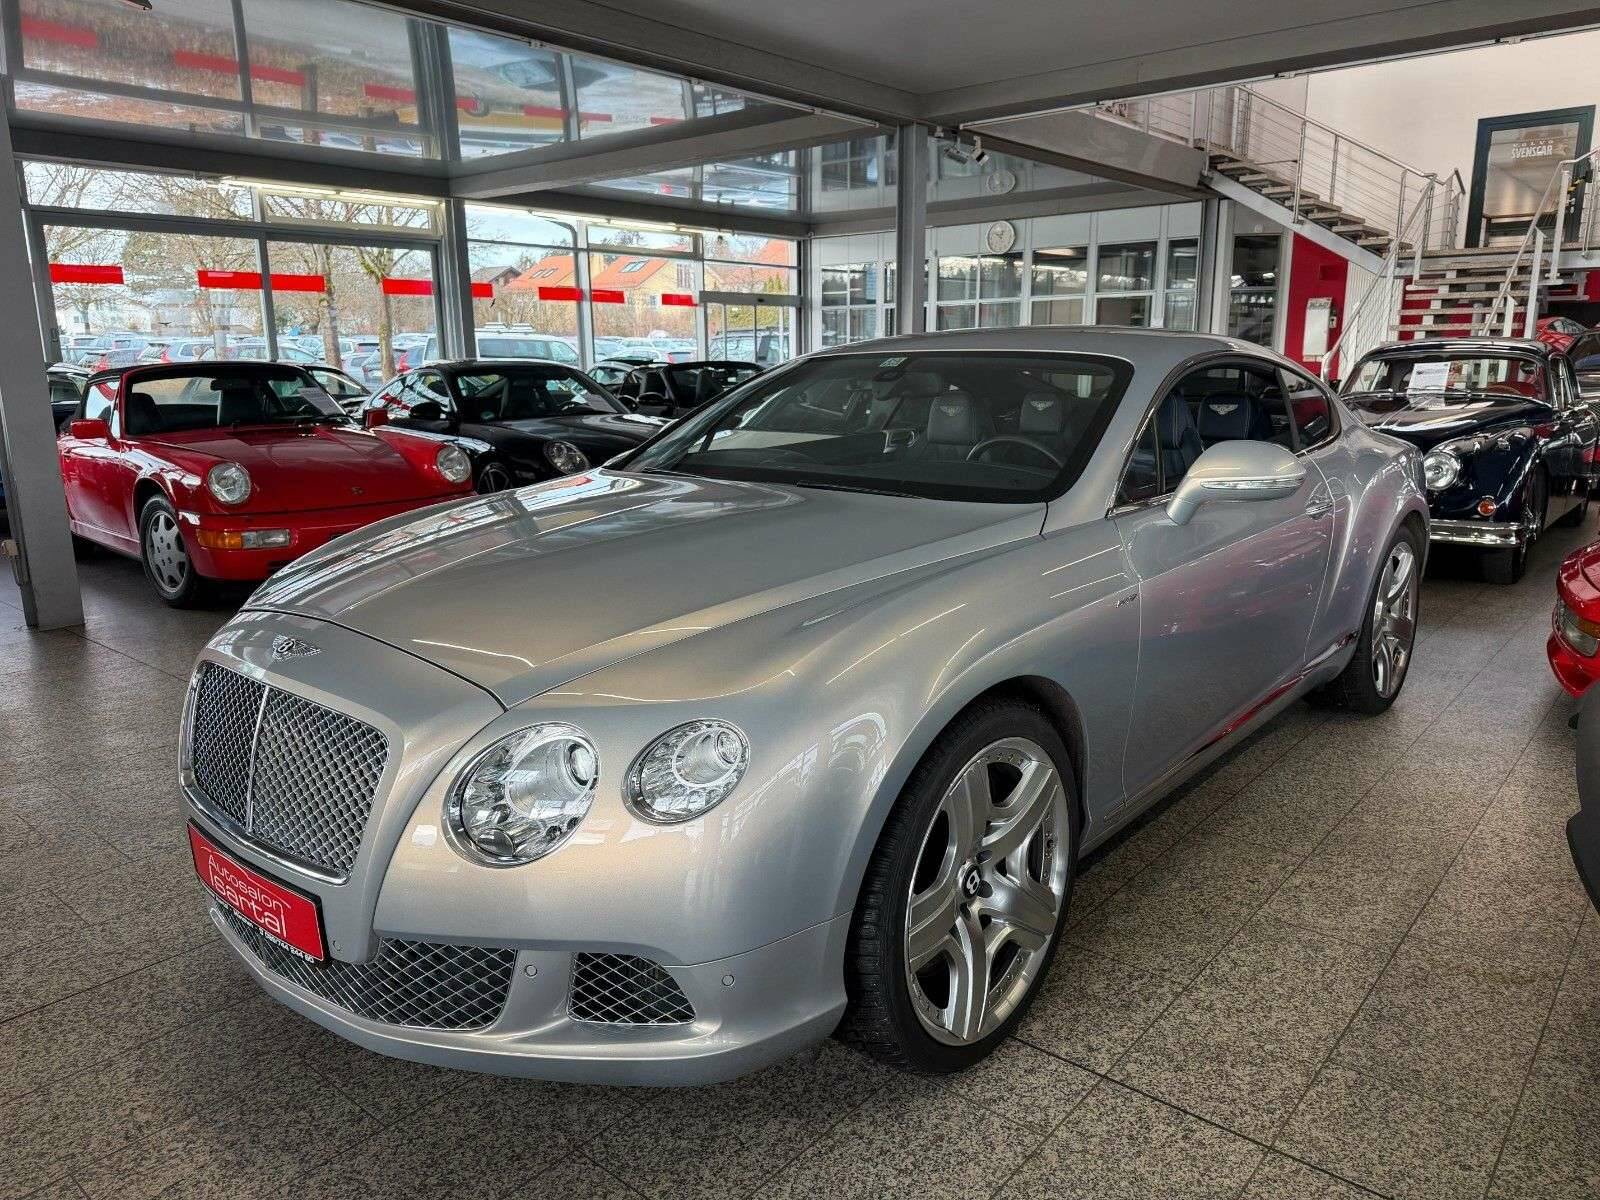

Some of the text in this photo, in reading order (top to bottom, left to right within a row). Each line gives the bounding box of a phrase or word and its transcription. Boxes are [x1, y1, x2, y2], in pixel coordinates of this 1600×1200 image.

[1511, 144, 1553, 158] SVENSCAR
[208, 854, 283, 909] Autosalon
[209, 865, 287, 938] Isartal
